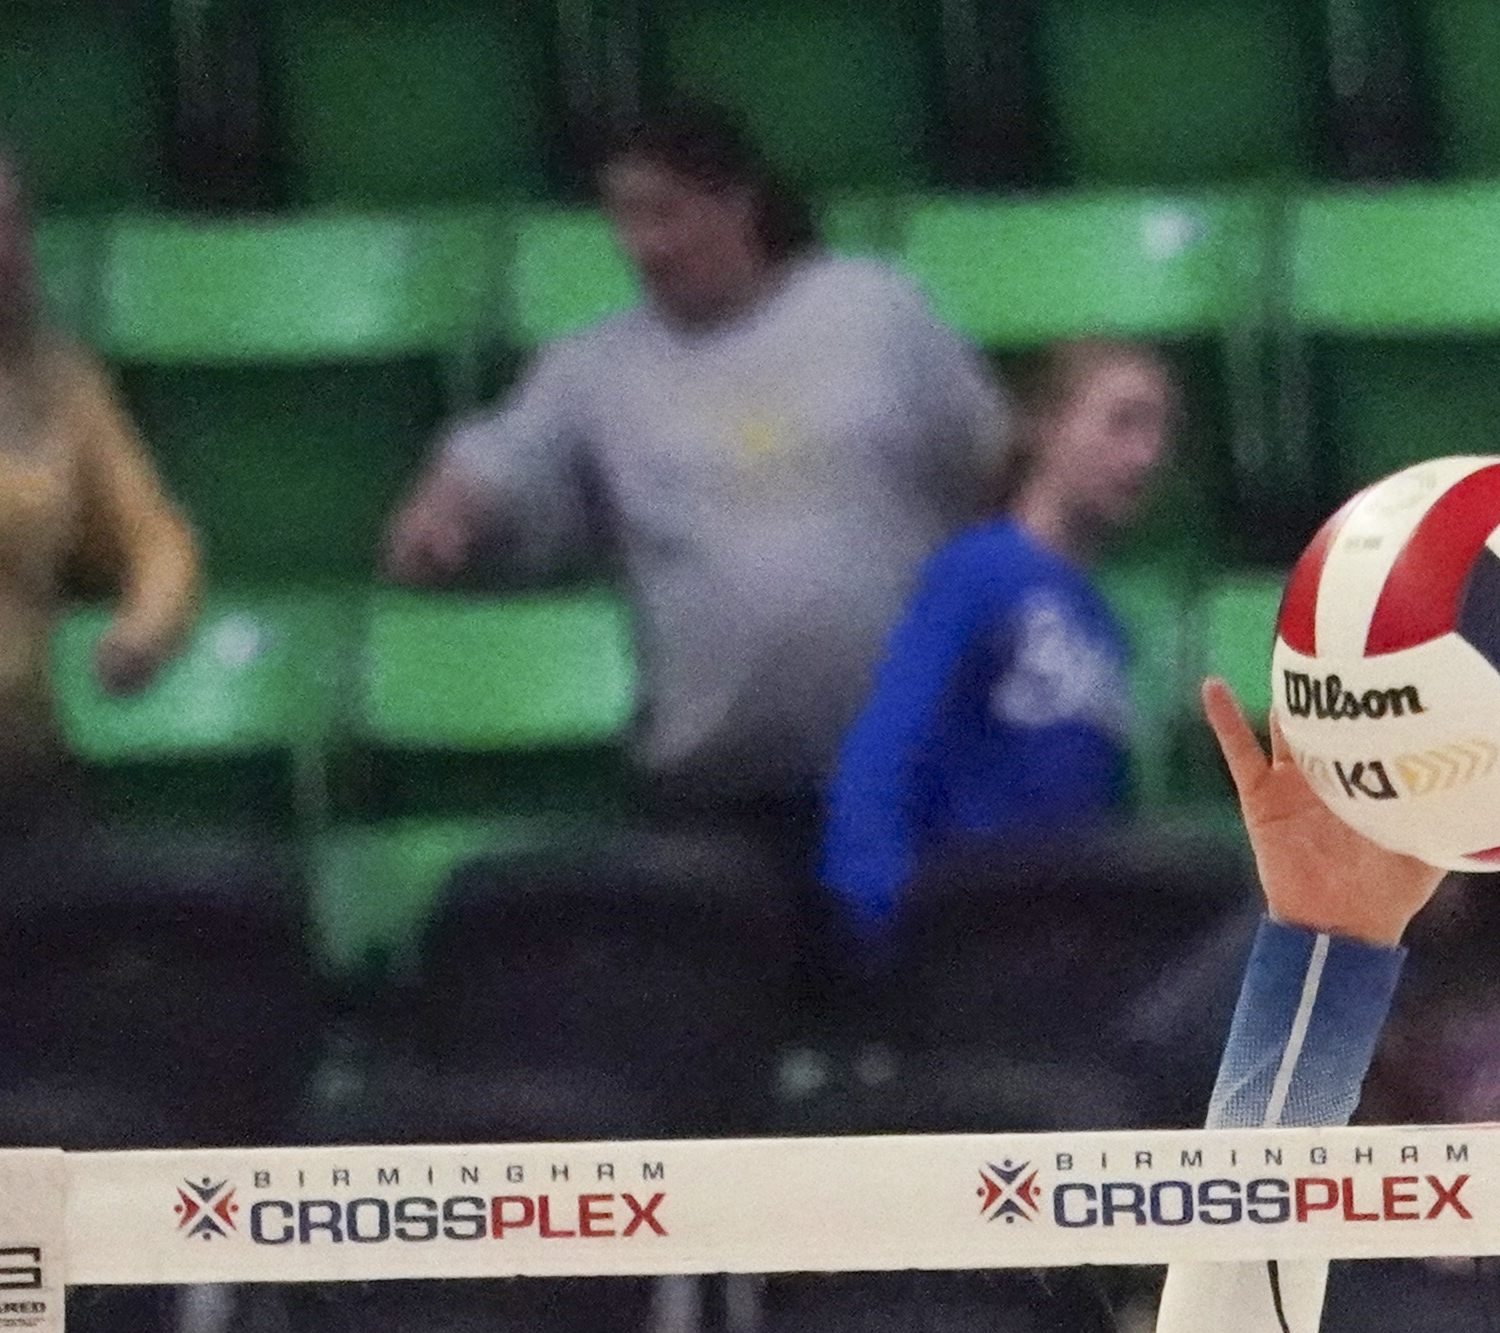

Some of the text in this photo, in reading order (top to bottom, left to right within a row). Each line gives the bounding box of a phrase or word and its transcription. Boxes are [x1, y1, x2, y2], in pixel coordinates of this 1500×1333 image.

[1284, 670, 1426, 720] Wilson
[253, 1161, 665, 1190] BIRMINGHAM
[1055, 1143, 1470, 1172] BIRMINGHAM
[249, 1192, 669, 1246] CROSSPLEX
[1052, 1174, 1473, 1228] CROSSPLEX
